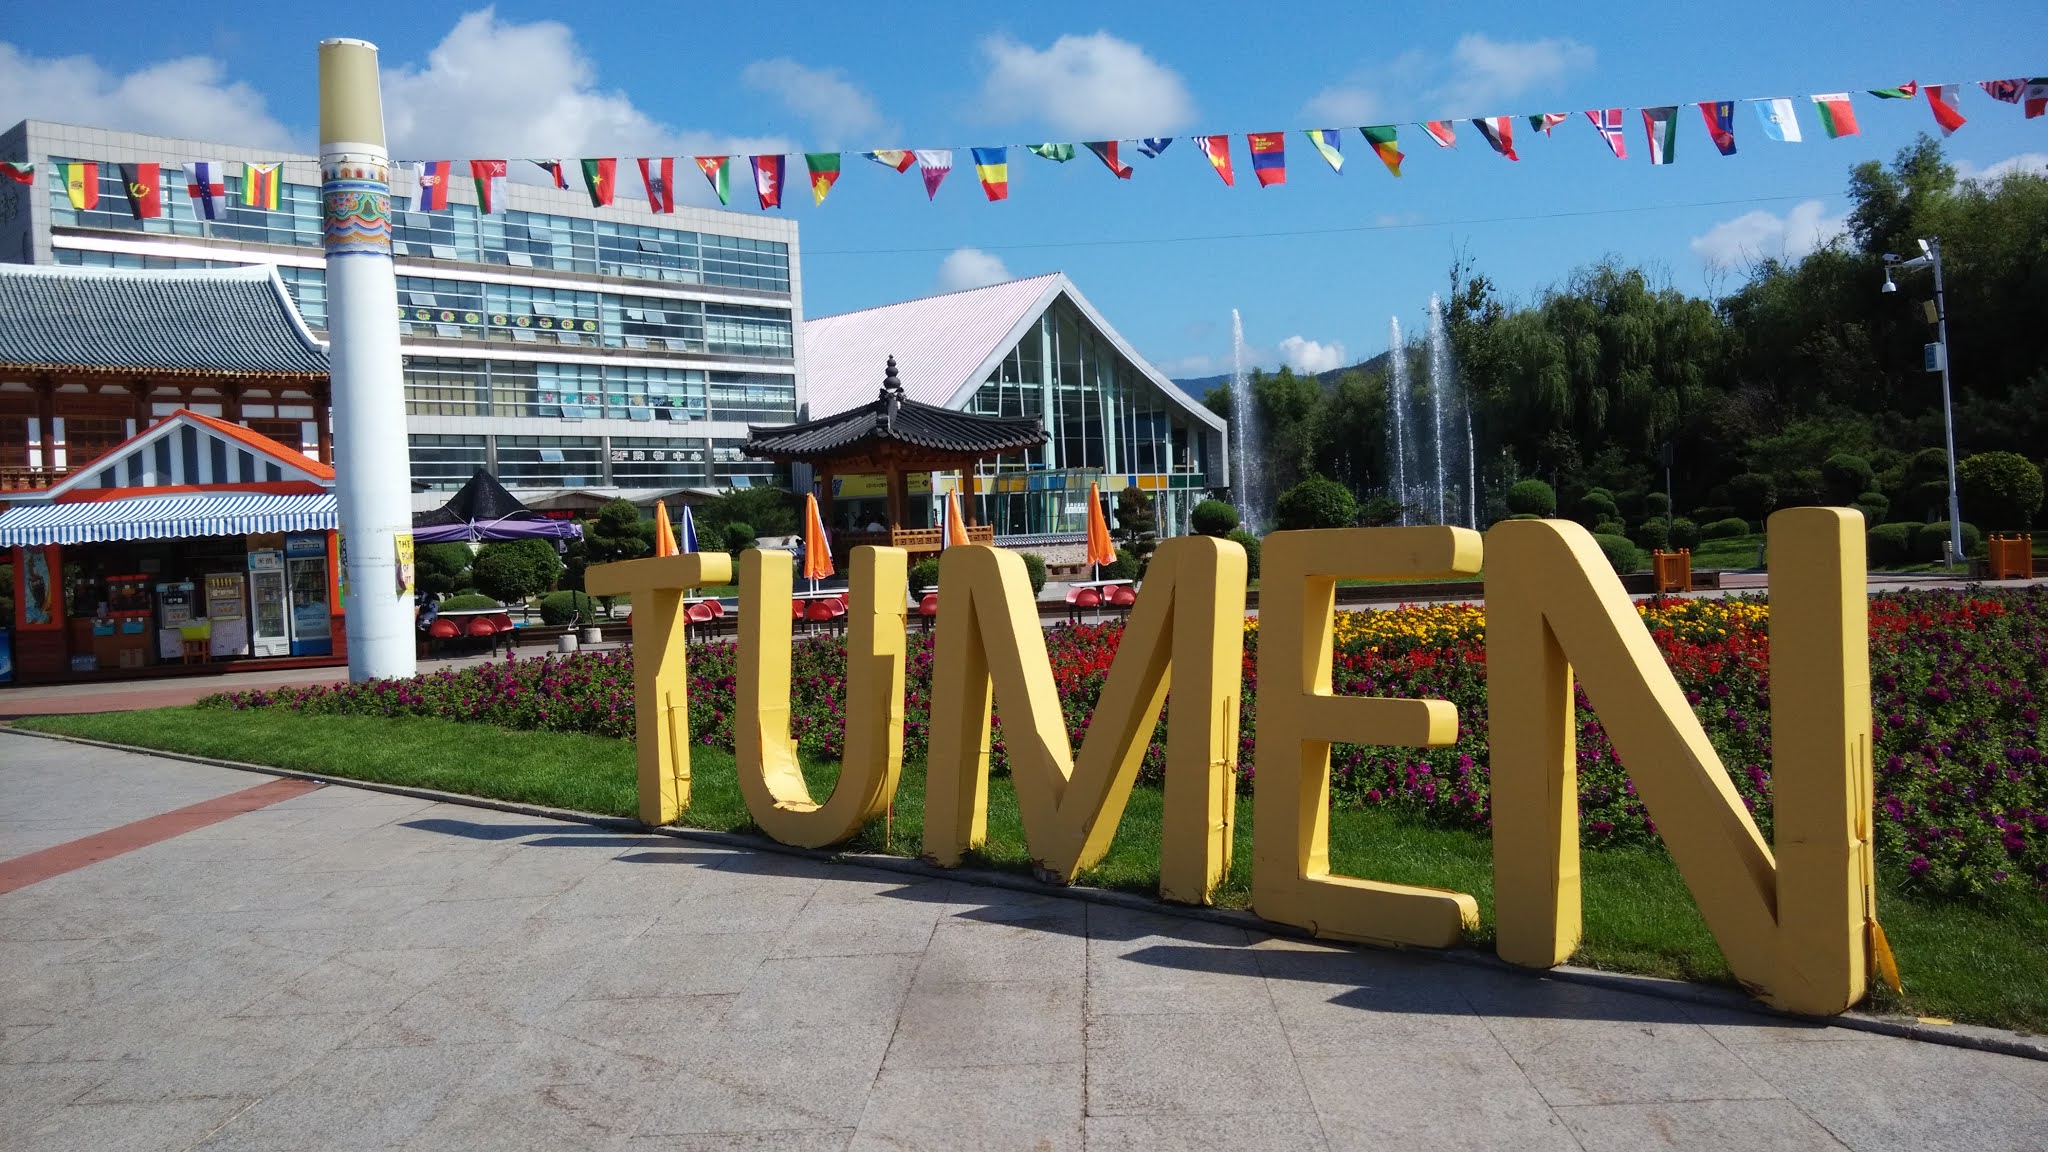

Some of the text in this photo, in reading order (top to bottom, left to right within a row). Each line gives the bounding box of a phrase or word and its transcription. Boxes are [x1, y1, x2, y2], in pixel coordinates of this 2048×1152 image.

[611, 450, 629, 461] 2F
[632, 450, 702, 461] 购物中心
[398, 540, 411, 549] THE
[585, 507, 1874, 1016] TUMEN
